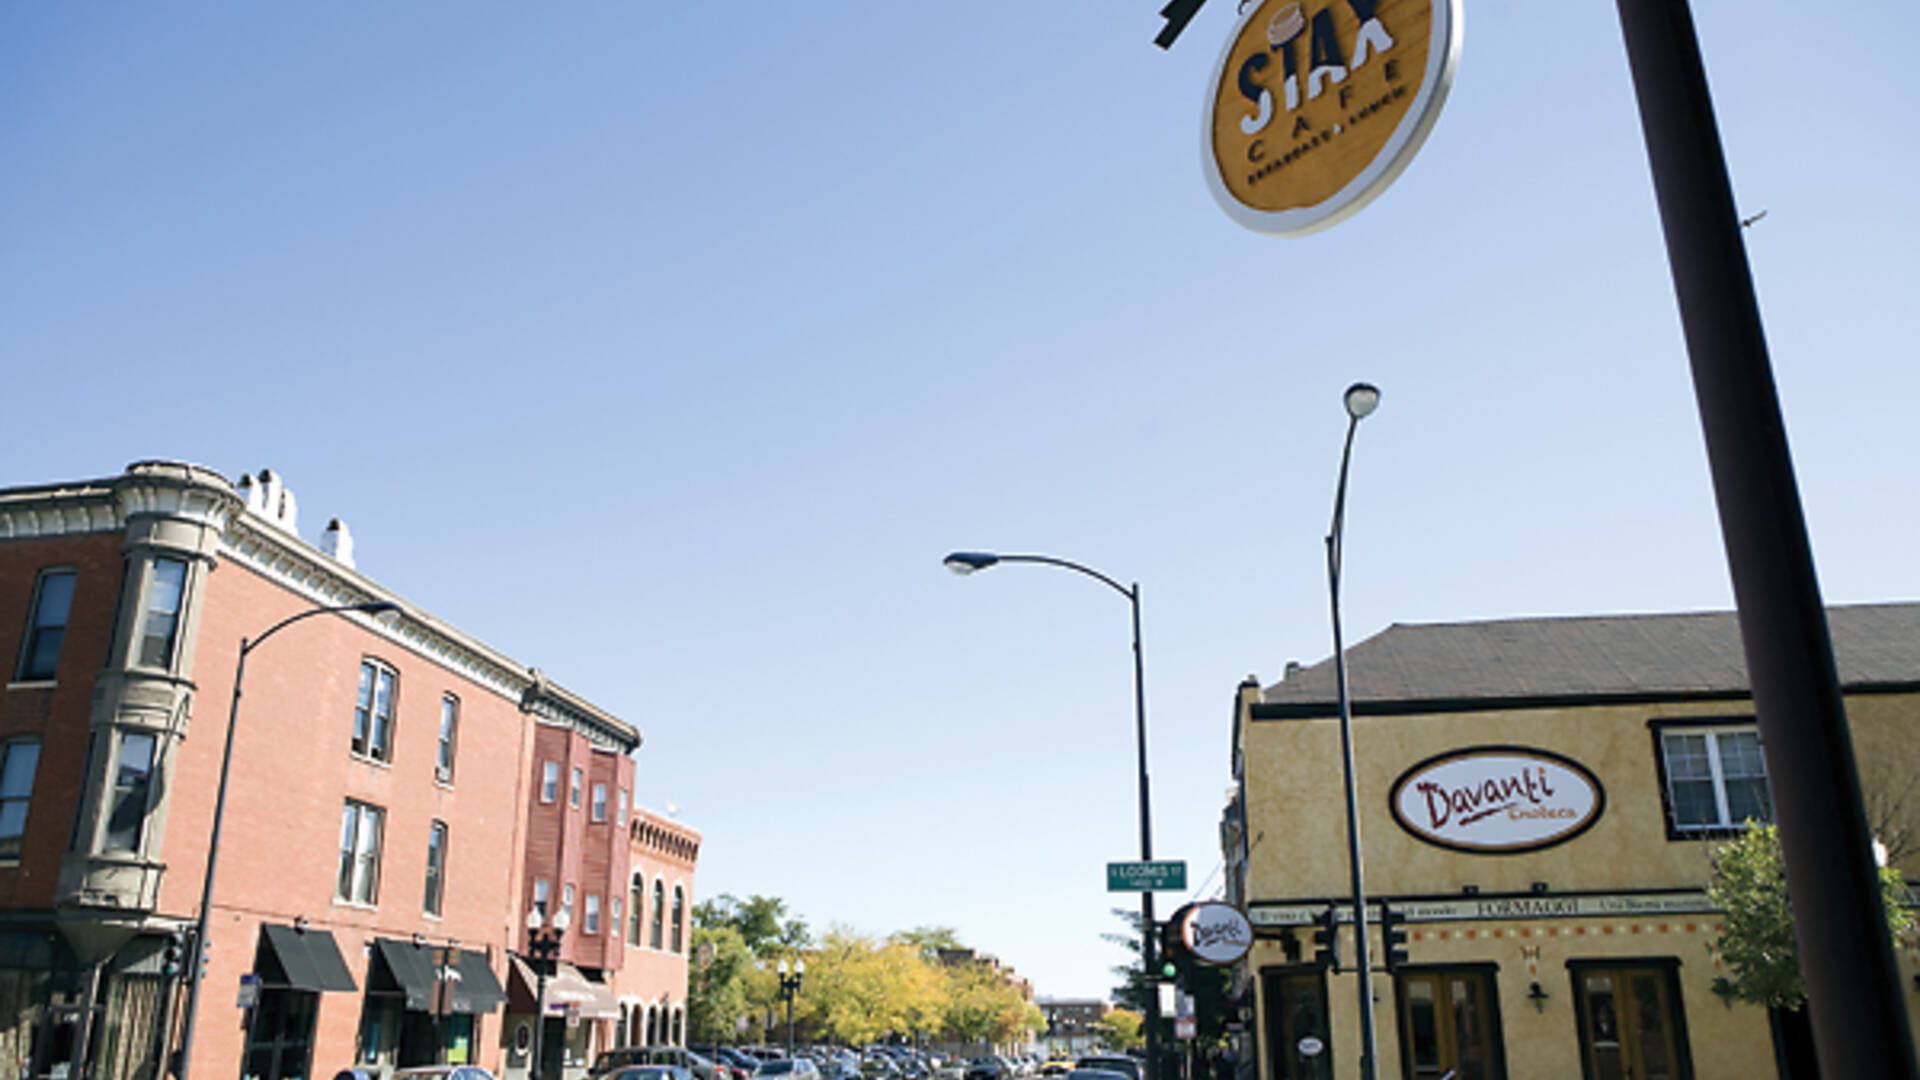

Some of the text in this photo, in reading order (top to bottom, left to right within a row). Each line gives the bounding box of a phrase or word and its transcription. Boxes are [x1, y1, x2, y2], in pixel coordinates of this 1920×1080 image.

[1238, 0, 1394, 134] STAX
[1247, 59, 1399, 162] CAFE
[1416, 767, 1554, 829] Davanti
